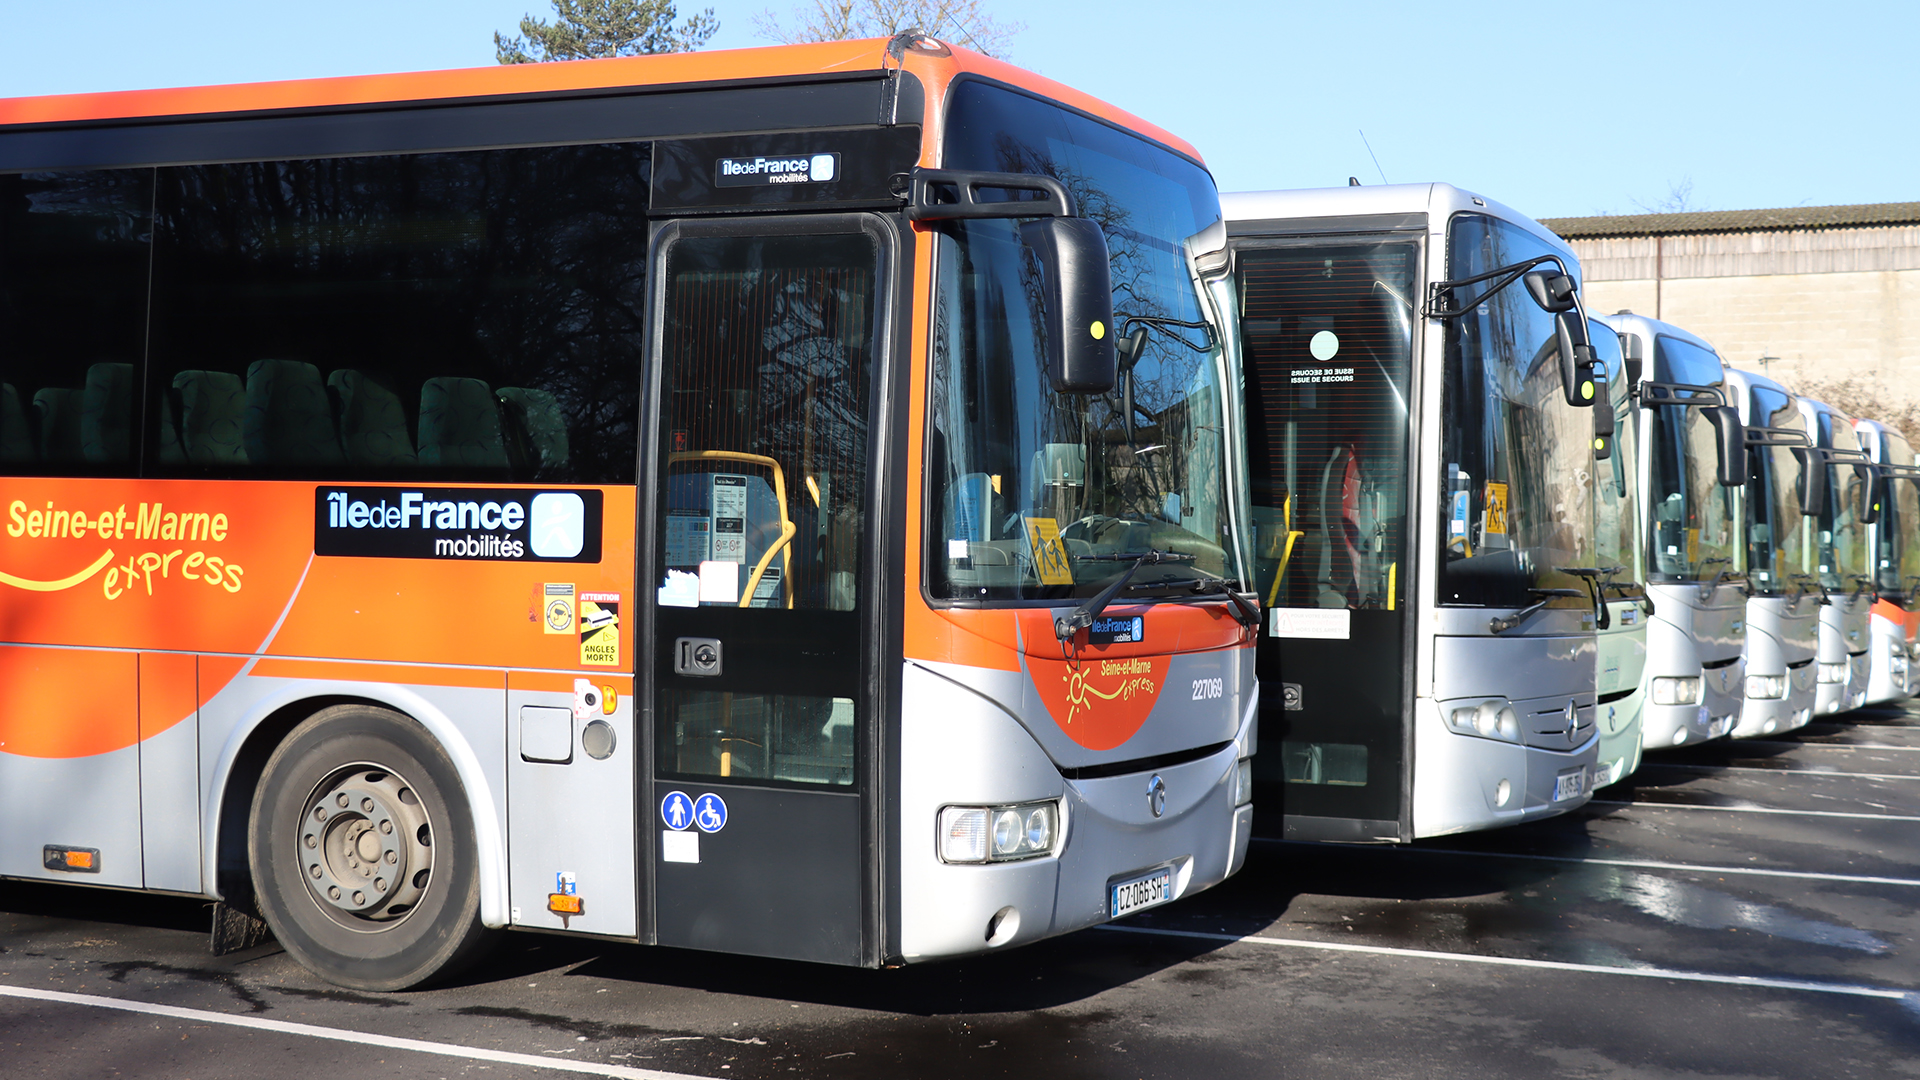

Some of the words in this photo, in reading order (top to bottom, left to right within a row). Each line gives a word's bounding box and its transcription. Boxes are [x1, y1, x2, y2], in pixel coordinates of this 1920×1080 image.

[769, 172, 809, 184] mobilités
[1322, 375, 1354, 383] SECOURS
[7, 500, 229, 542] Seine-et-Marne
[435, 533, 525, 558] mobilités
[103, 549, 244, 600] express
[580, 593, 620, 602] ATTENTION
[584, 645, 615, 653] ANGLES
[586, 654, 614, 662] MORTS
[1100, 658, 1151, 676] Seine-et-Marne
[1123, 677, 1155, 701] express
[1192, 678, 1223, 700] 227069
[1119, 876, 1164, 911] CZ-066-SH
